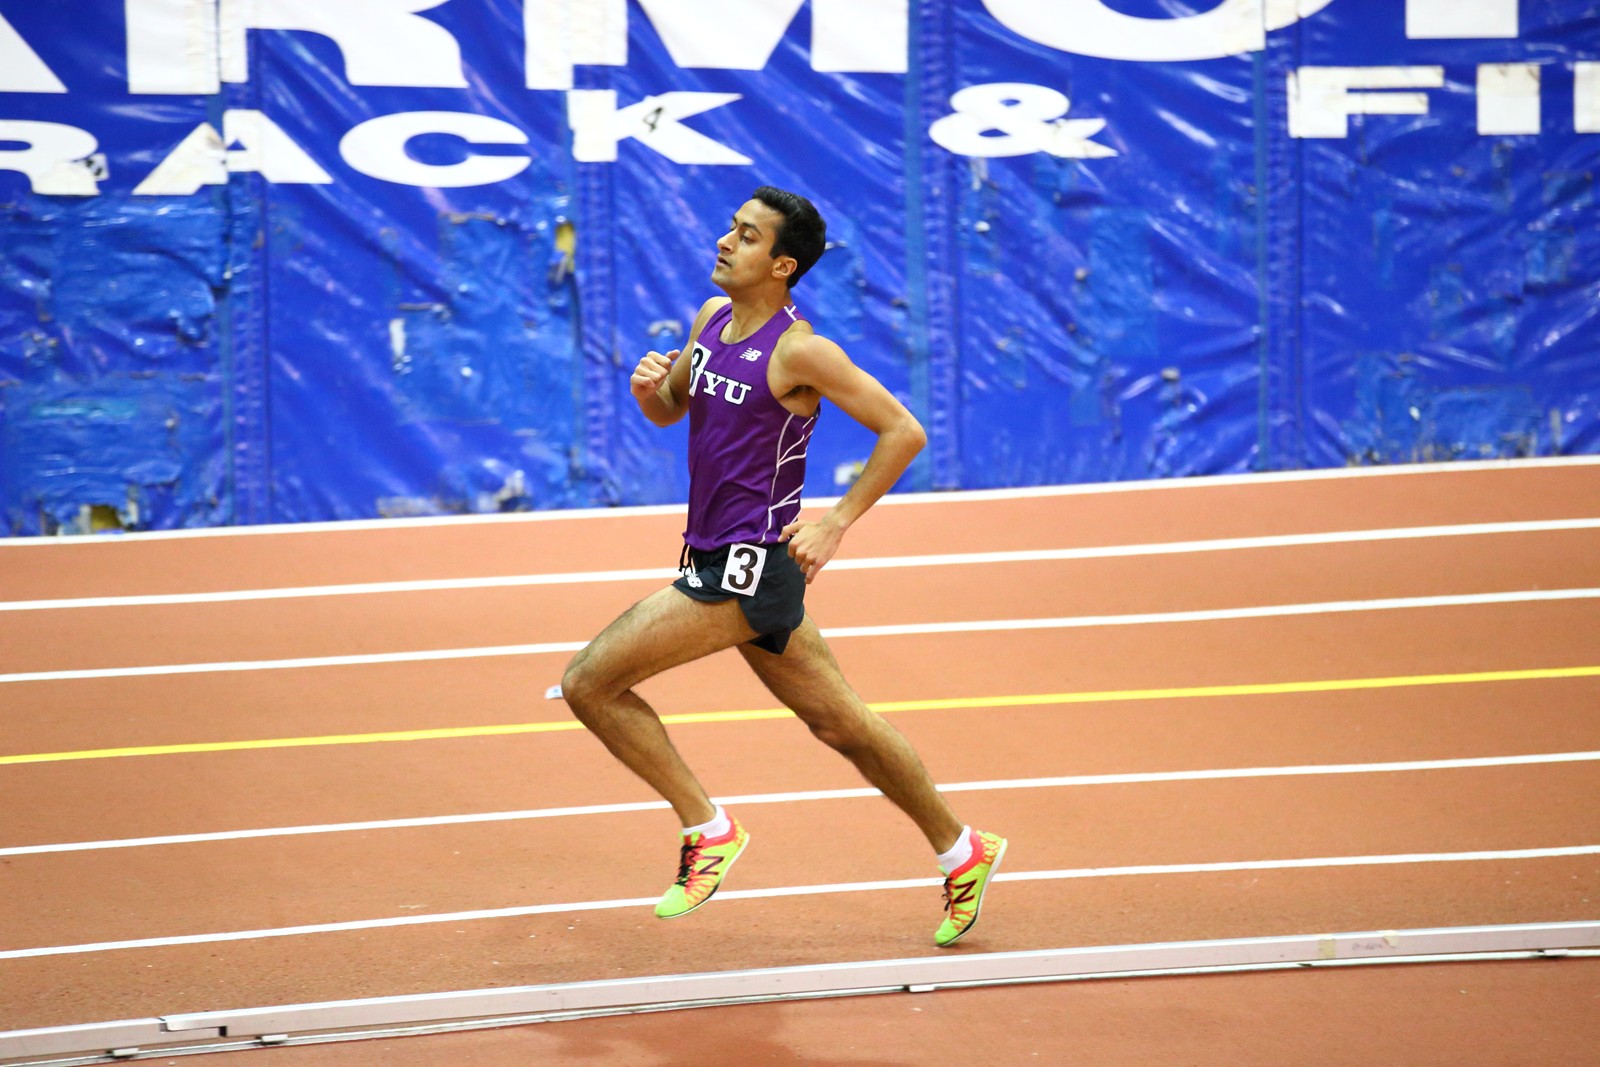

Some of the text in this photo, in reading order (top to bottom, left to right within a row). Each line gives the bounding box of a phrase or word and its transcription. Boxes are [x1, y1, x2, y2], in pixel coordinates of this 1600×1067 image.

[928, 82, 1118, 159] &
[1287, 61, 1600, 138] FI
[701, 369, 753, 406] YU
[727, 547, 759, 590] 3
